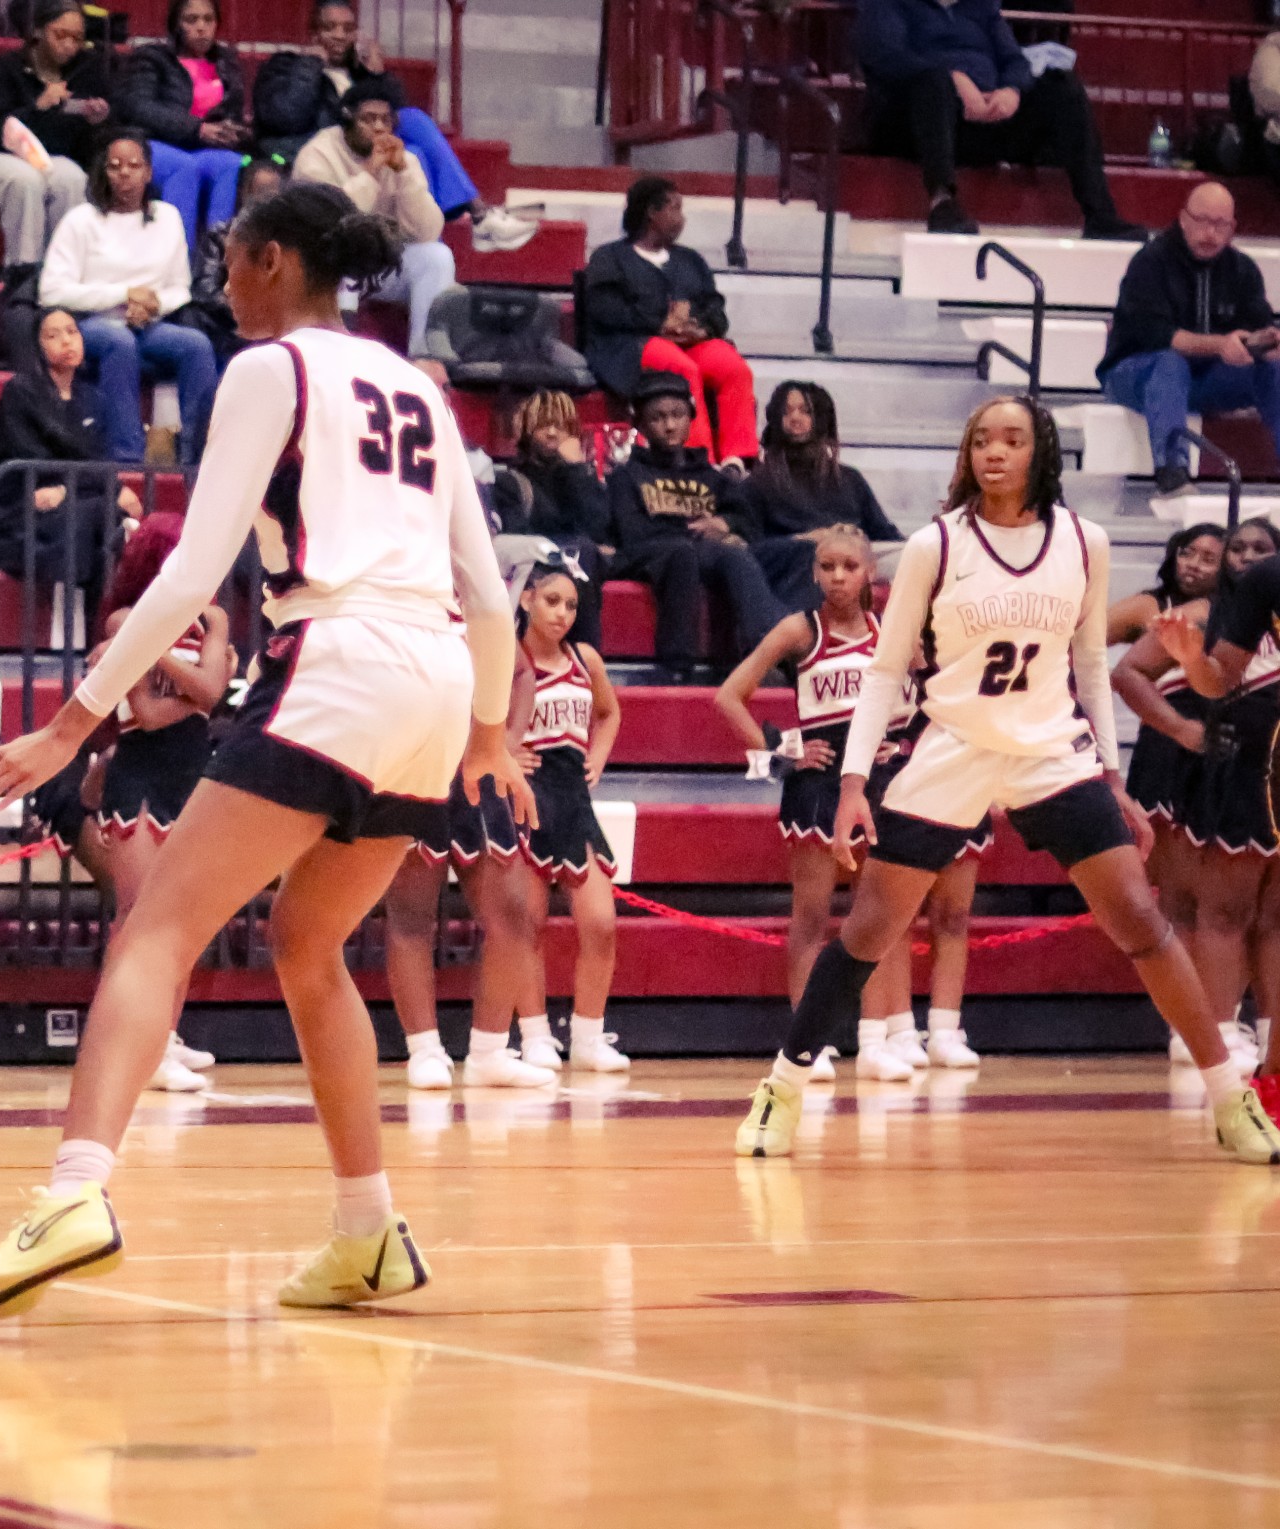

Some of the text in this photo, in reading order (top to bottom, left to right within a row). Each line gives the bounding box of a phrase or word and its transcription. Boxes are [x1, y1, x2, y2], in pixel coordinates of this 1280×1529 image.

[350, 376, 437, 496] 32
[956, 591, 1075, 638] ROBINS
[811, 667, 862, 704] WR
[977, 640, 1041, 697] 21
